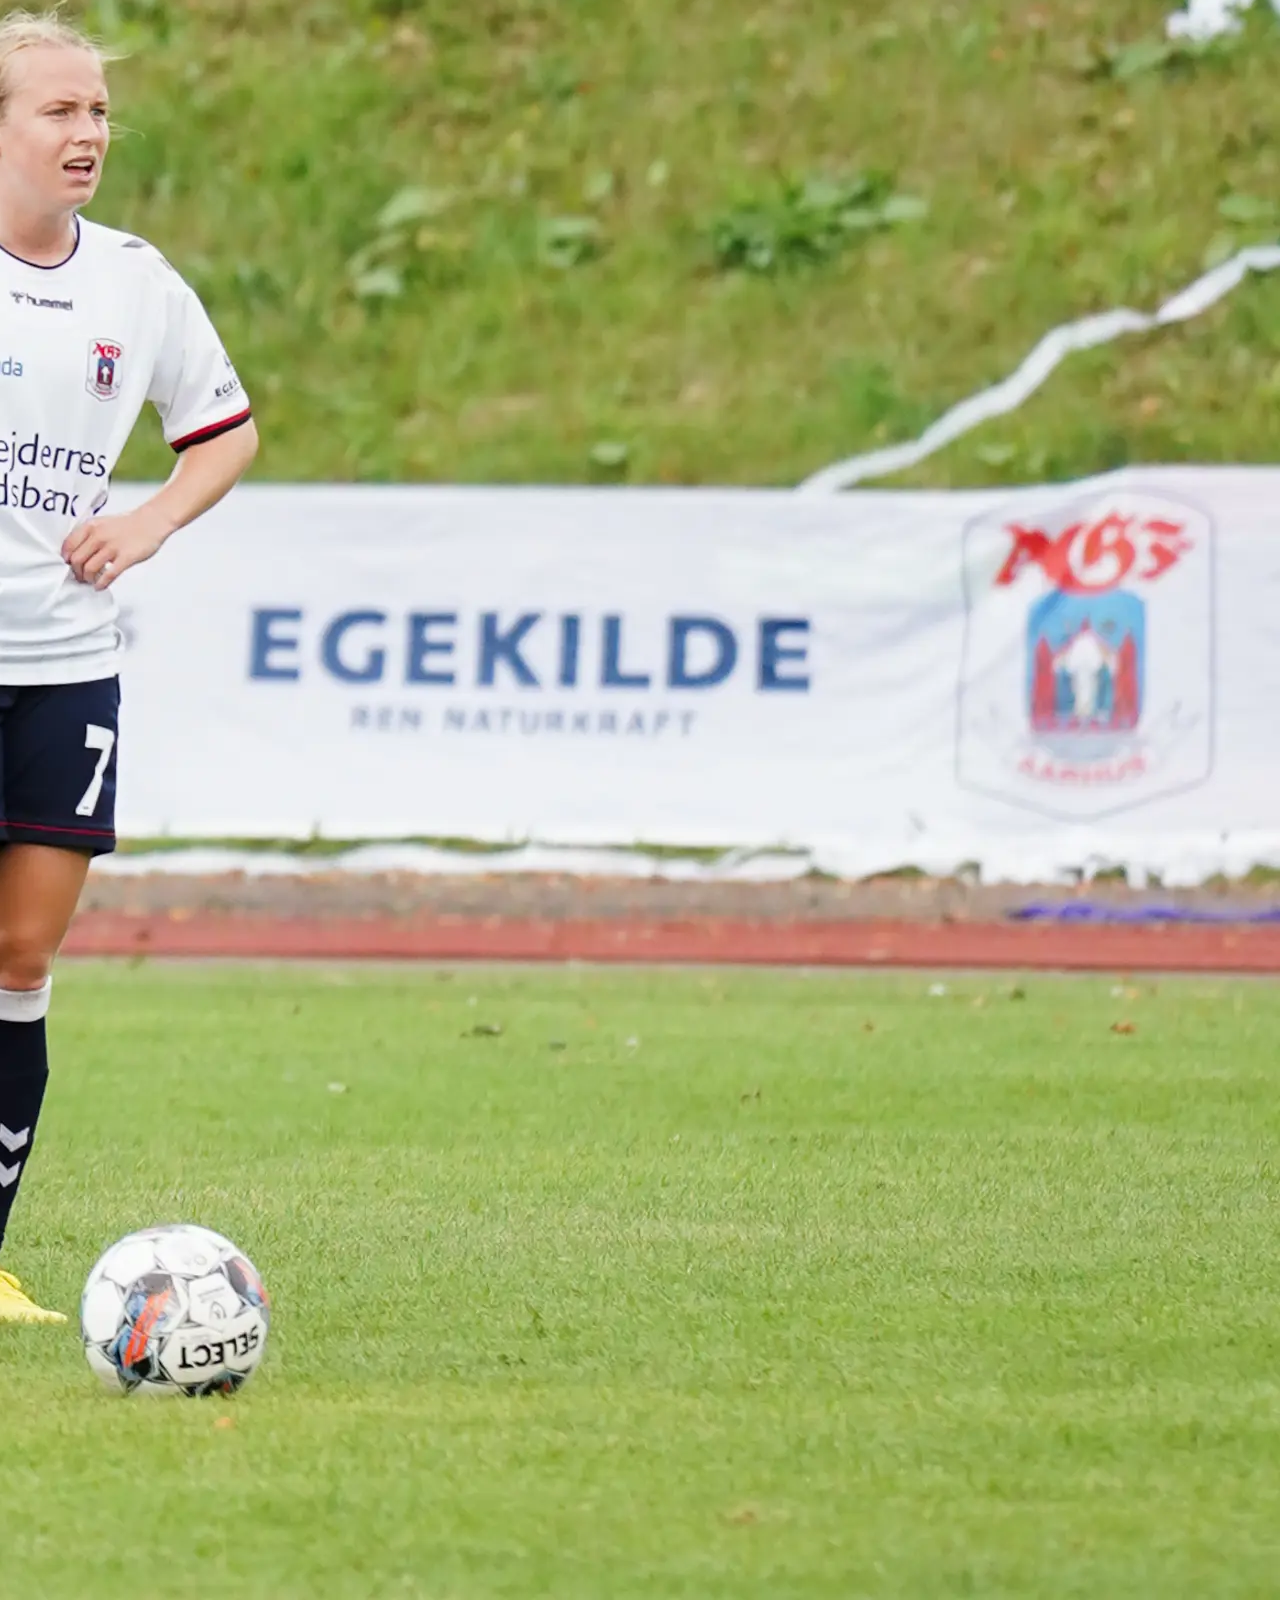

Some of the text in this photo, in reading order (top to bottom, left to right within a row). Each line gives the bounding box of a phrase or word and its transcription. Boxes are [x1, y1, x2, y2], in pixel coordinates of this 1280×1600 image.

[247, 607, 813, 693] EGEKILDE
[350, 705, 698, 738] REN NATURKRAFT
[75, 723, 115, 817] 7
[178, 1324, 259, 1368] SELECT
